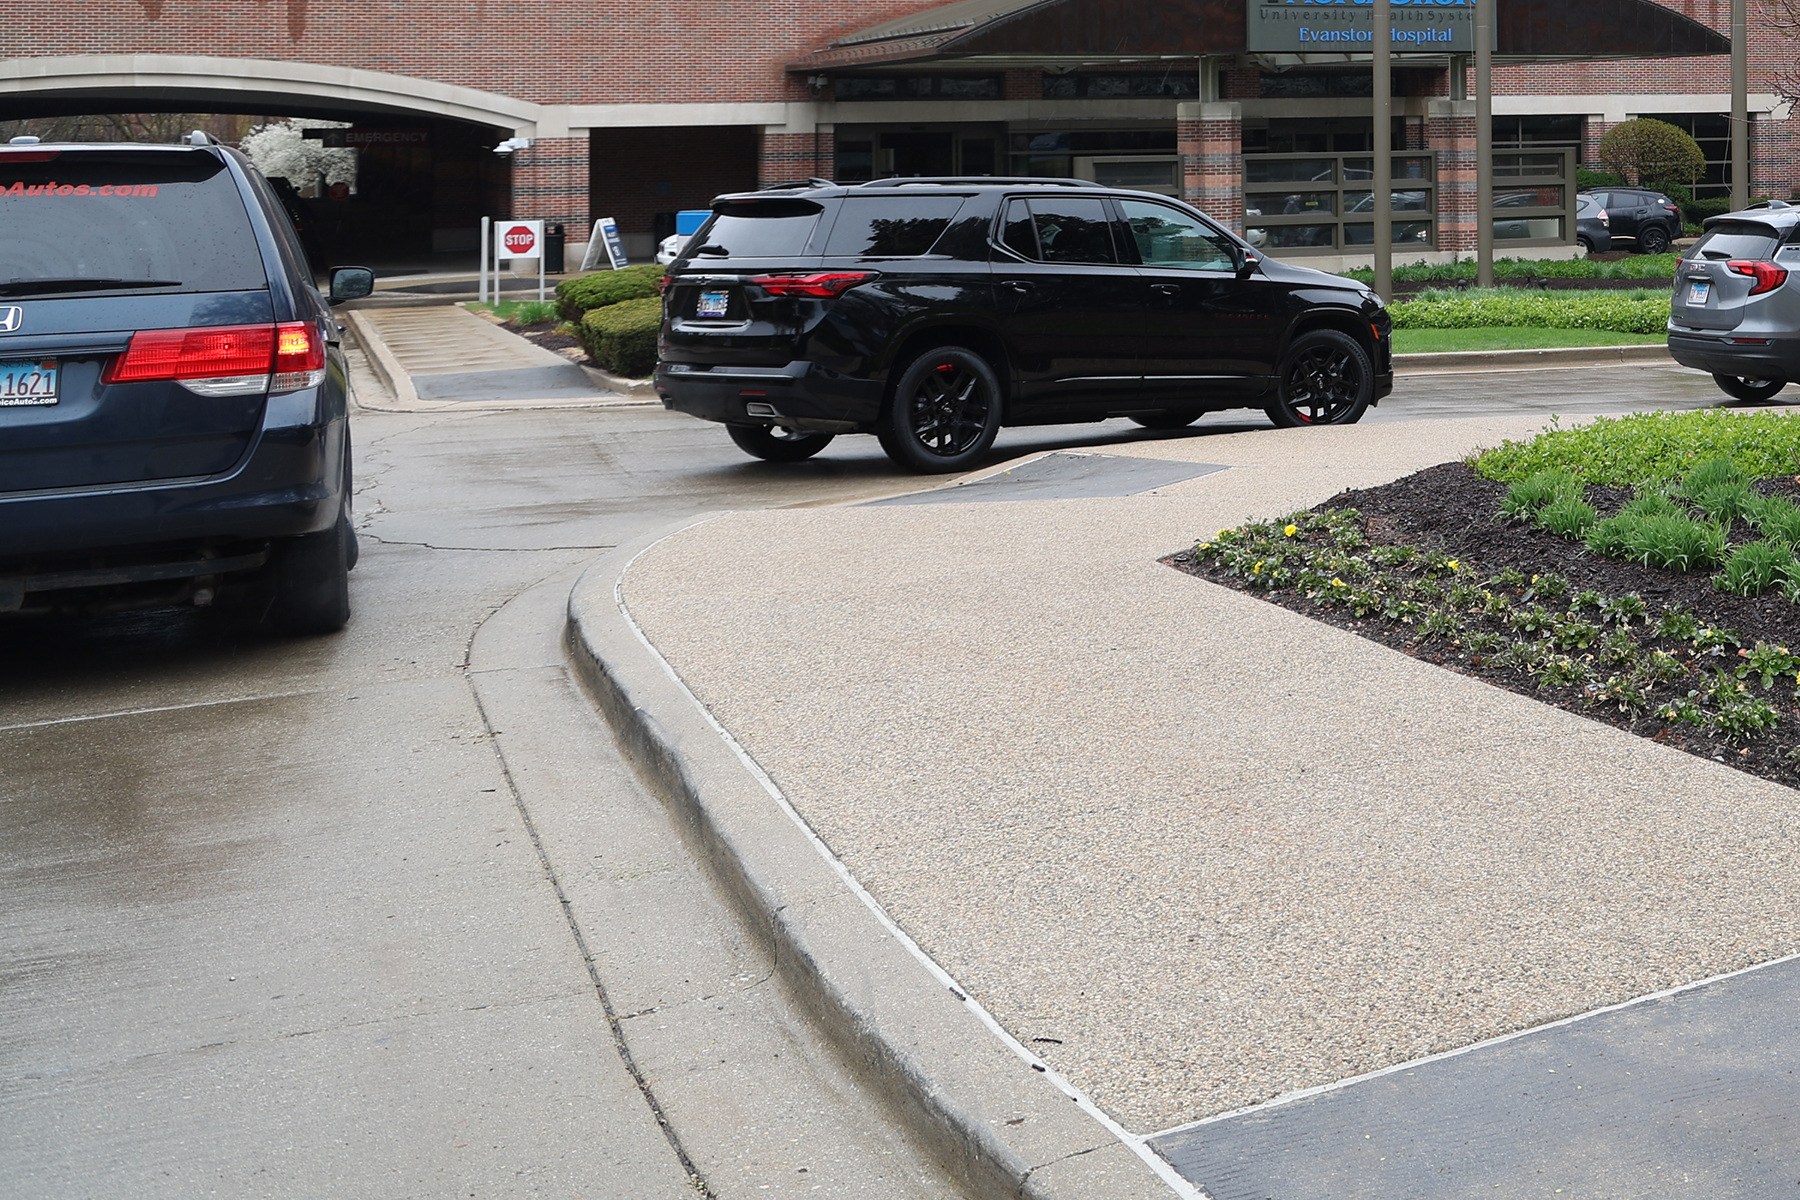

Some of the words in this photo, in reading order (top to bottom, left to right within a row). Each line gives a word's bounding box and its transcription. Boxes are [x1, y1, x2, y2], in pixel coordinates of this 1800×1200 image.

[1260, 9, 1356, 23] University
[345, 131, 430, 144] EMERGENCY
[505, 233, 533, 246] STOP
[0, 371, 54, 396] 1621
